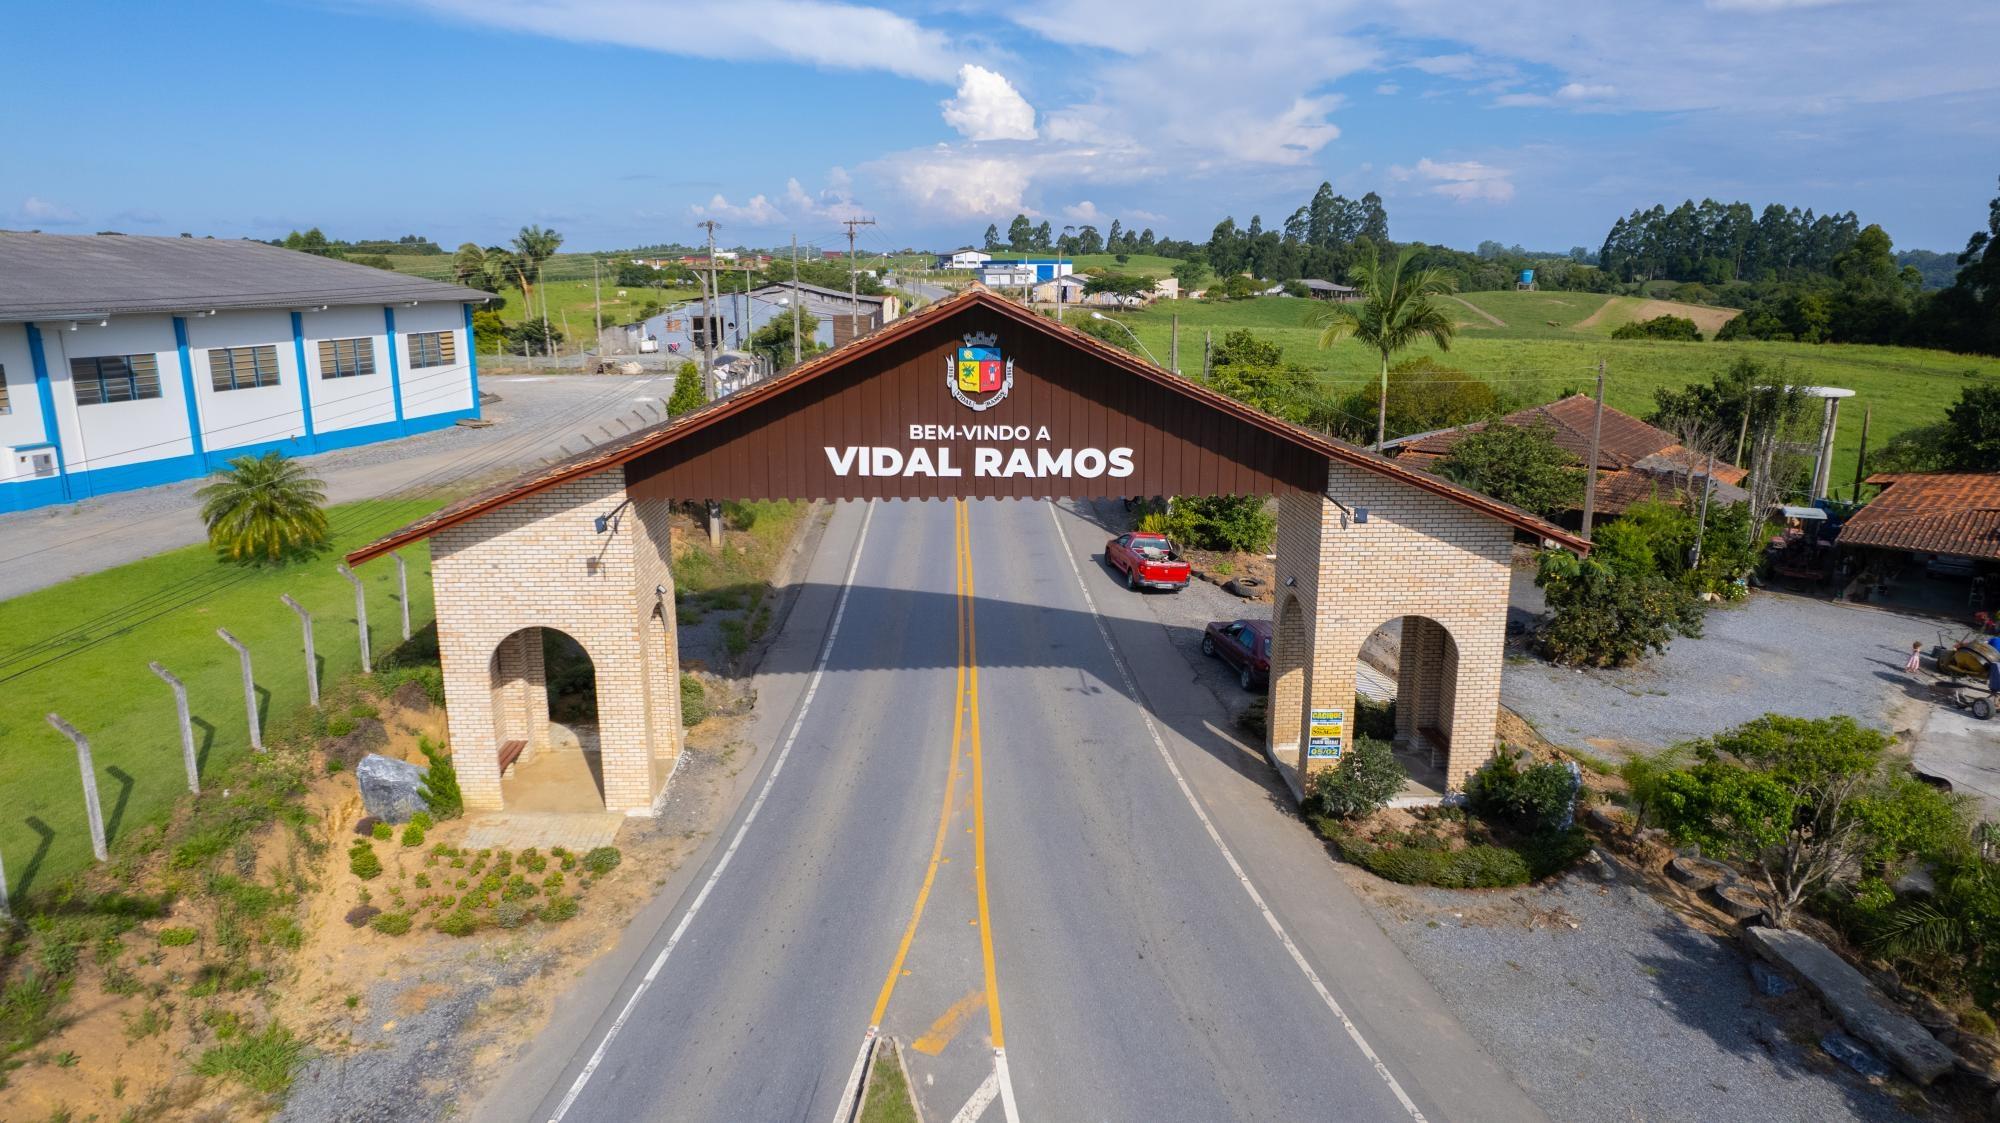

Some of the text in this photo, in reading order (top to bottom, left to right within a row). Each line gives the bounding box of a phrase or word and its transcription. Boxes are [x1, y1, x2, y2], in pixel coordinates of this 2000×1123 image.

[956, 391, 1006, 406] VIDAL RAMOS
[910, 424, 1051, 440] BEM-VINDO A
[824, 446, 1134, 478] VIDAL RAMOS
